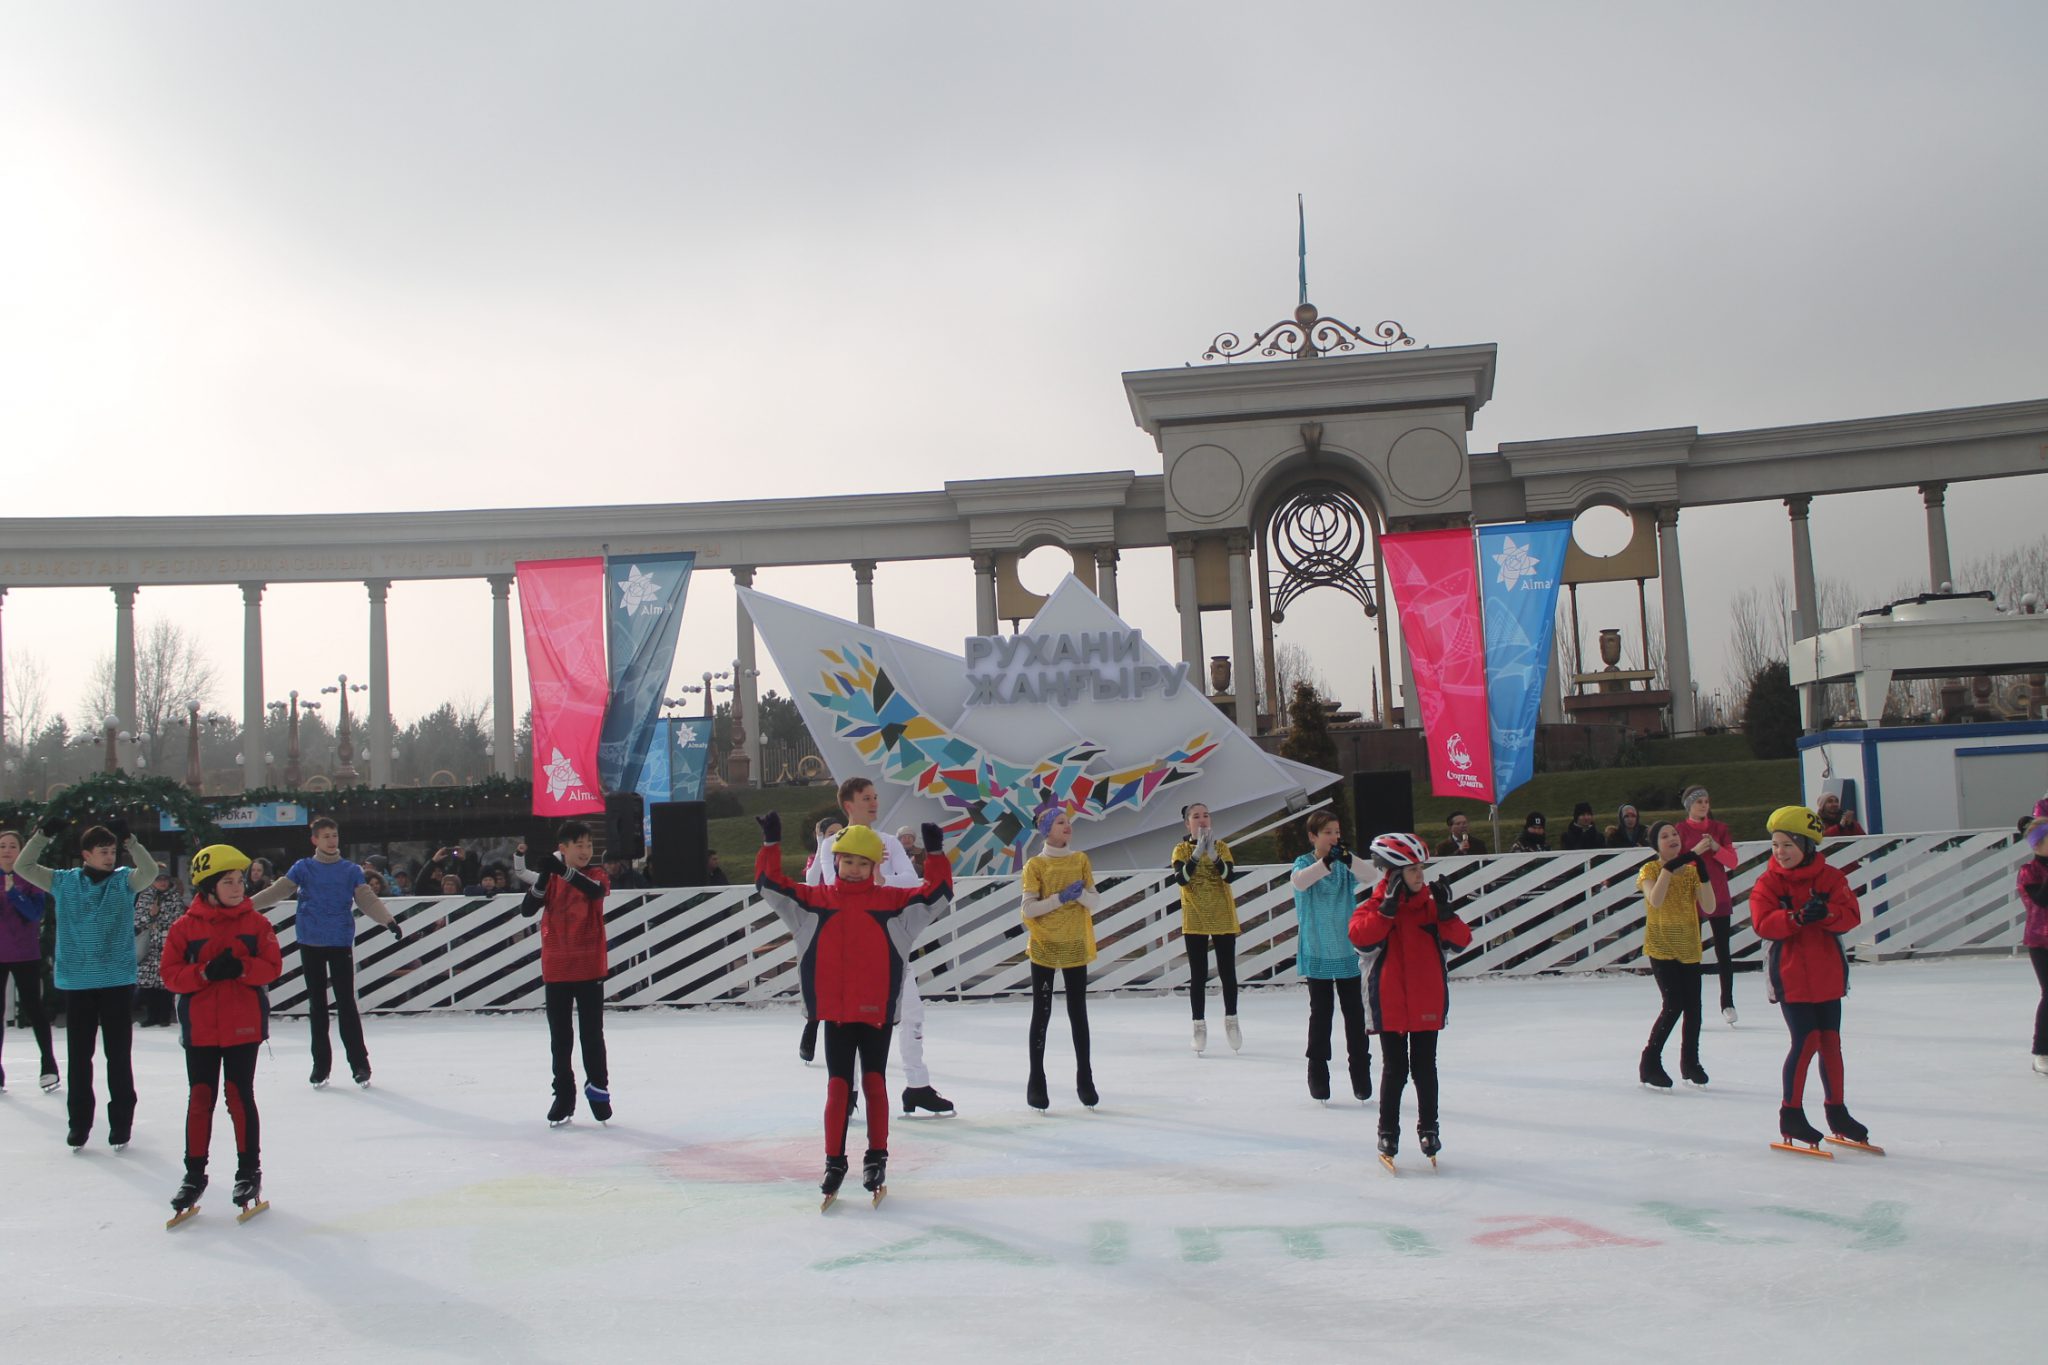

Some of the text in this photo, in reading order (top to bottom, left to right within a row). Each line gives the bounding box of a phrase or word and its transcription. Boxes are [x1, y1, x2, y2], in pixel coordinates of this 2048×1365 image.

[965, 629, 1142, 670] РУХАНИ
[965, 661, 1189, 708] ЖАҢҒЫРУ
[194, 853, 211, 873] 42
